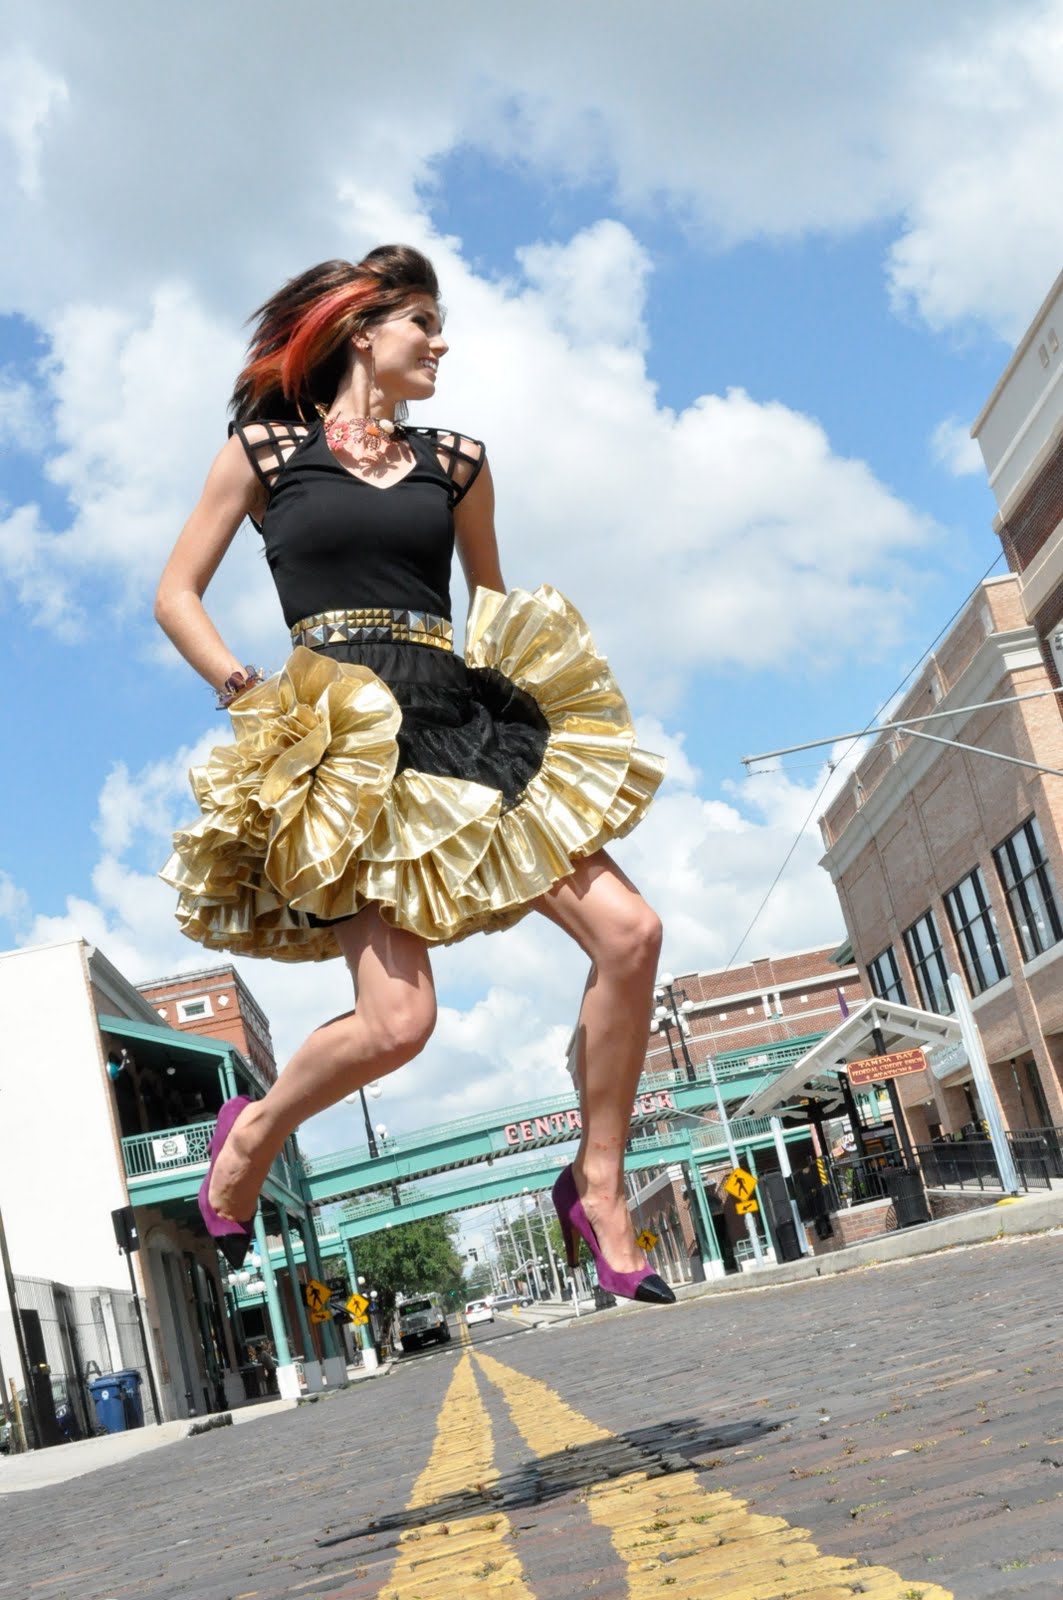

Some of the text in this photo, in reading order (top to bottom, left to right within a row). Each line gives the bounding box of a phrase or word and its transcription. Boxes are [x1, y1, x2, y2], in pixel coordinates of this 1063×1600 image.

[896, 1052, 913, 1060] BAY
[504, 1090, 673, 1146] CENTR OR
